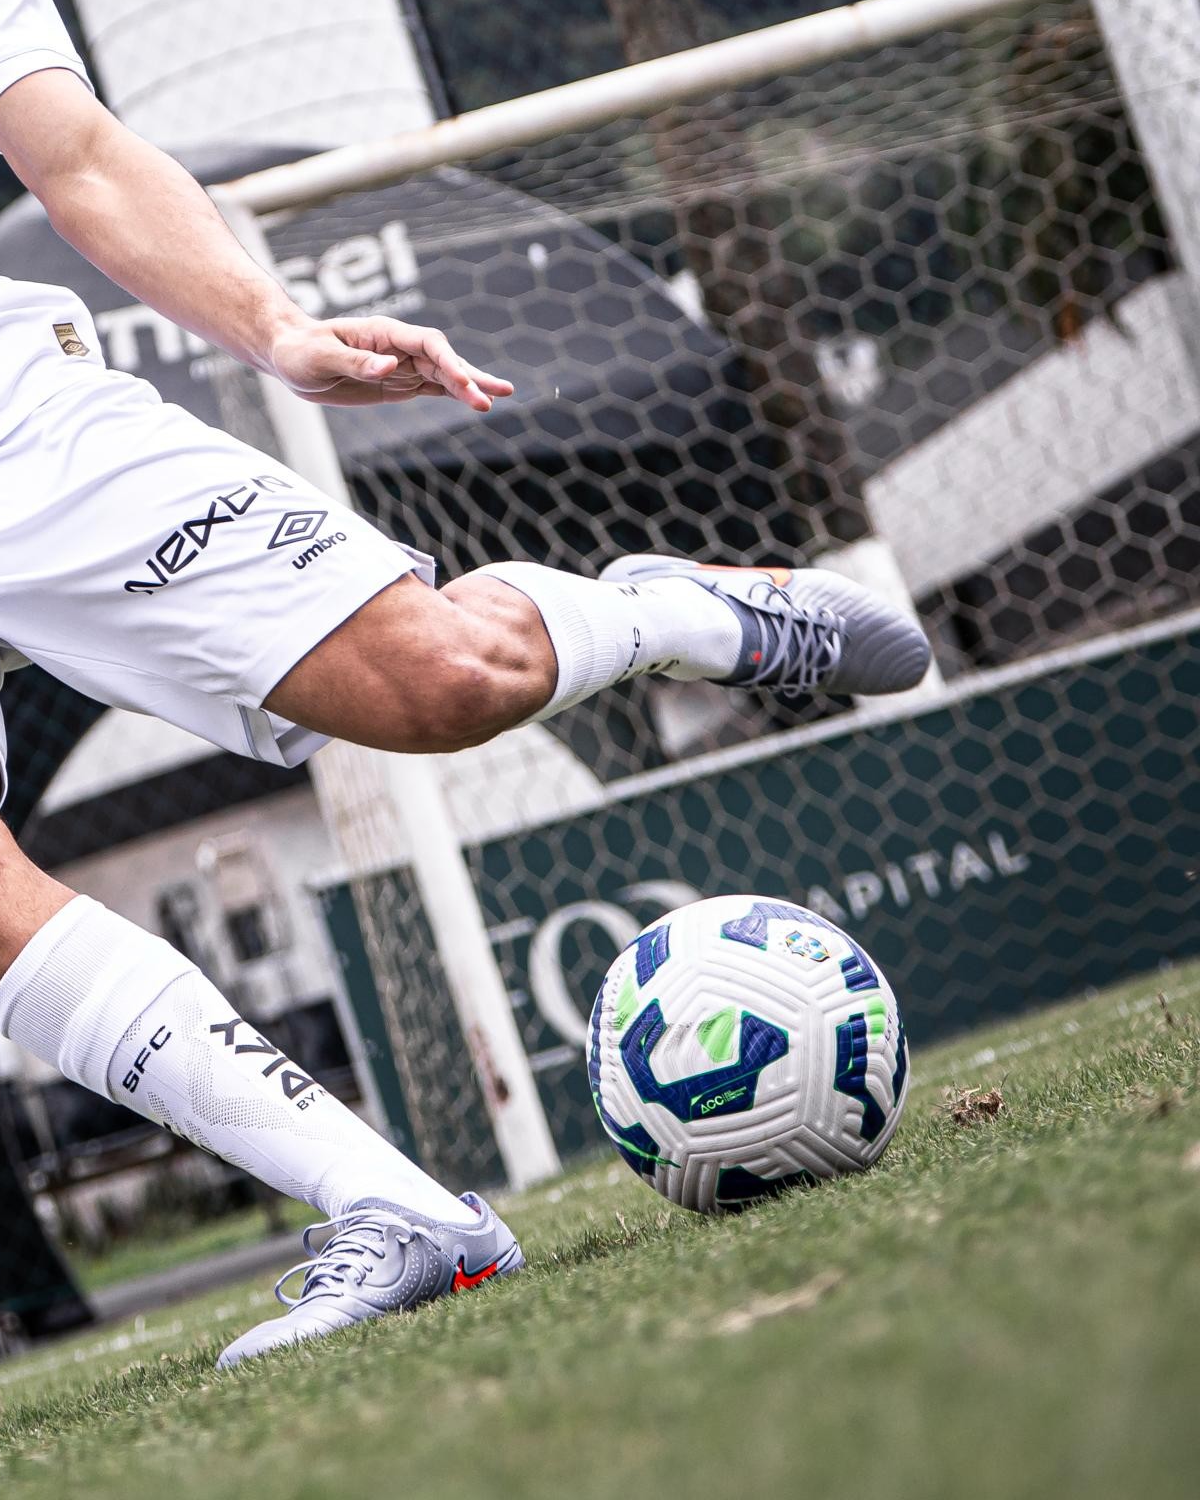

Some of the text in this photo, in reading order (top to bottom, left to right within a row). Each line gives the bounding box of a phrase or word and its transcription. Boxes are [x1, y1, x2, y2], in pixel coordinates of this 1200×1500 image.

[291, 531, 348, 570] umbro
[807, 830, 1031, 925] APITAL
[122, 1025, 172, 1093] SFC
